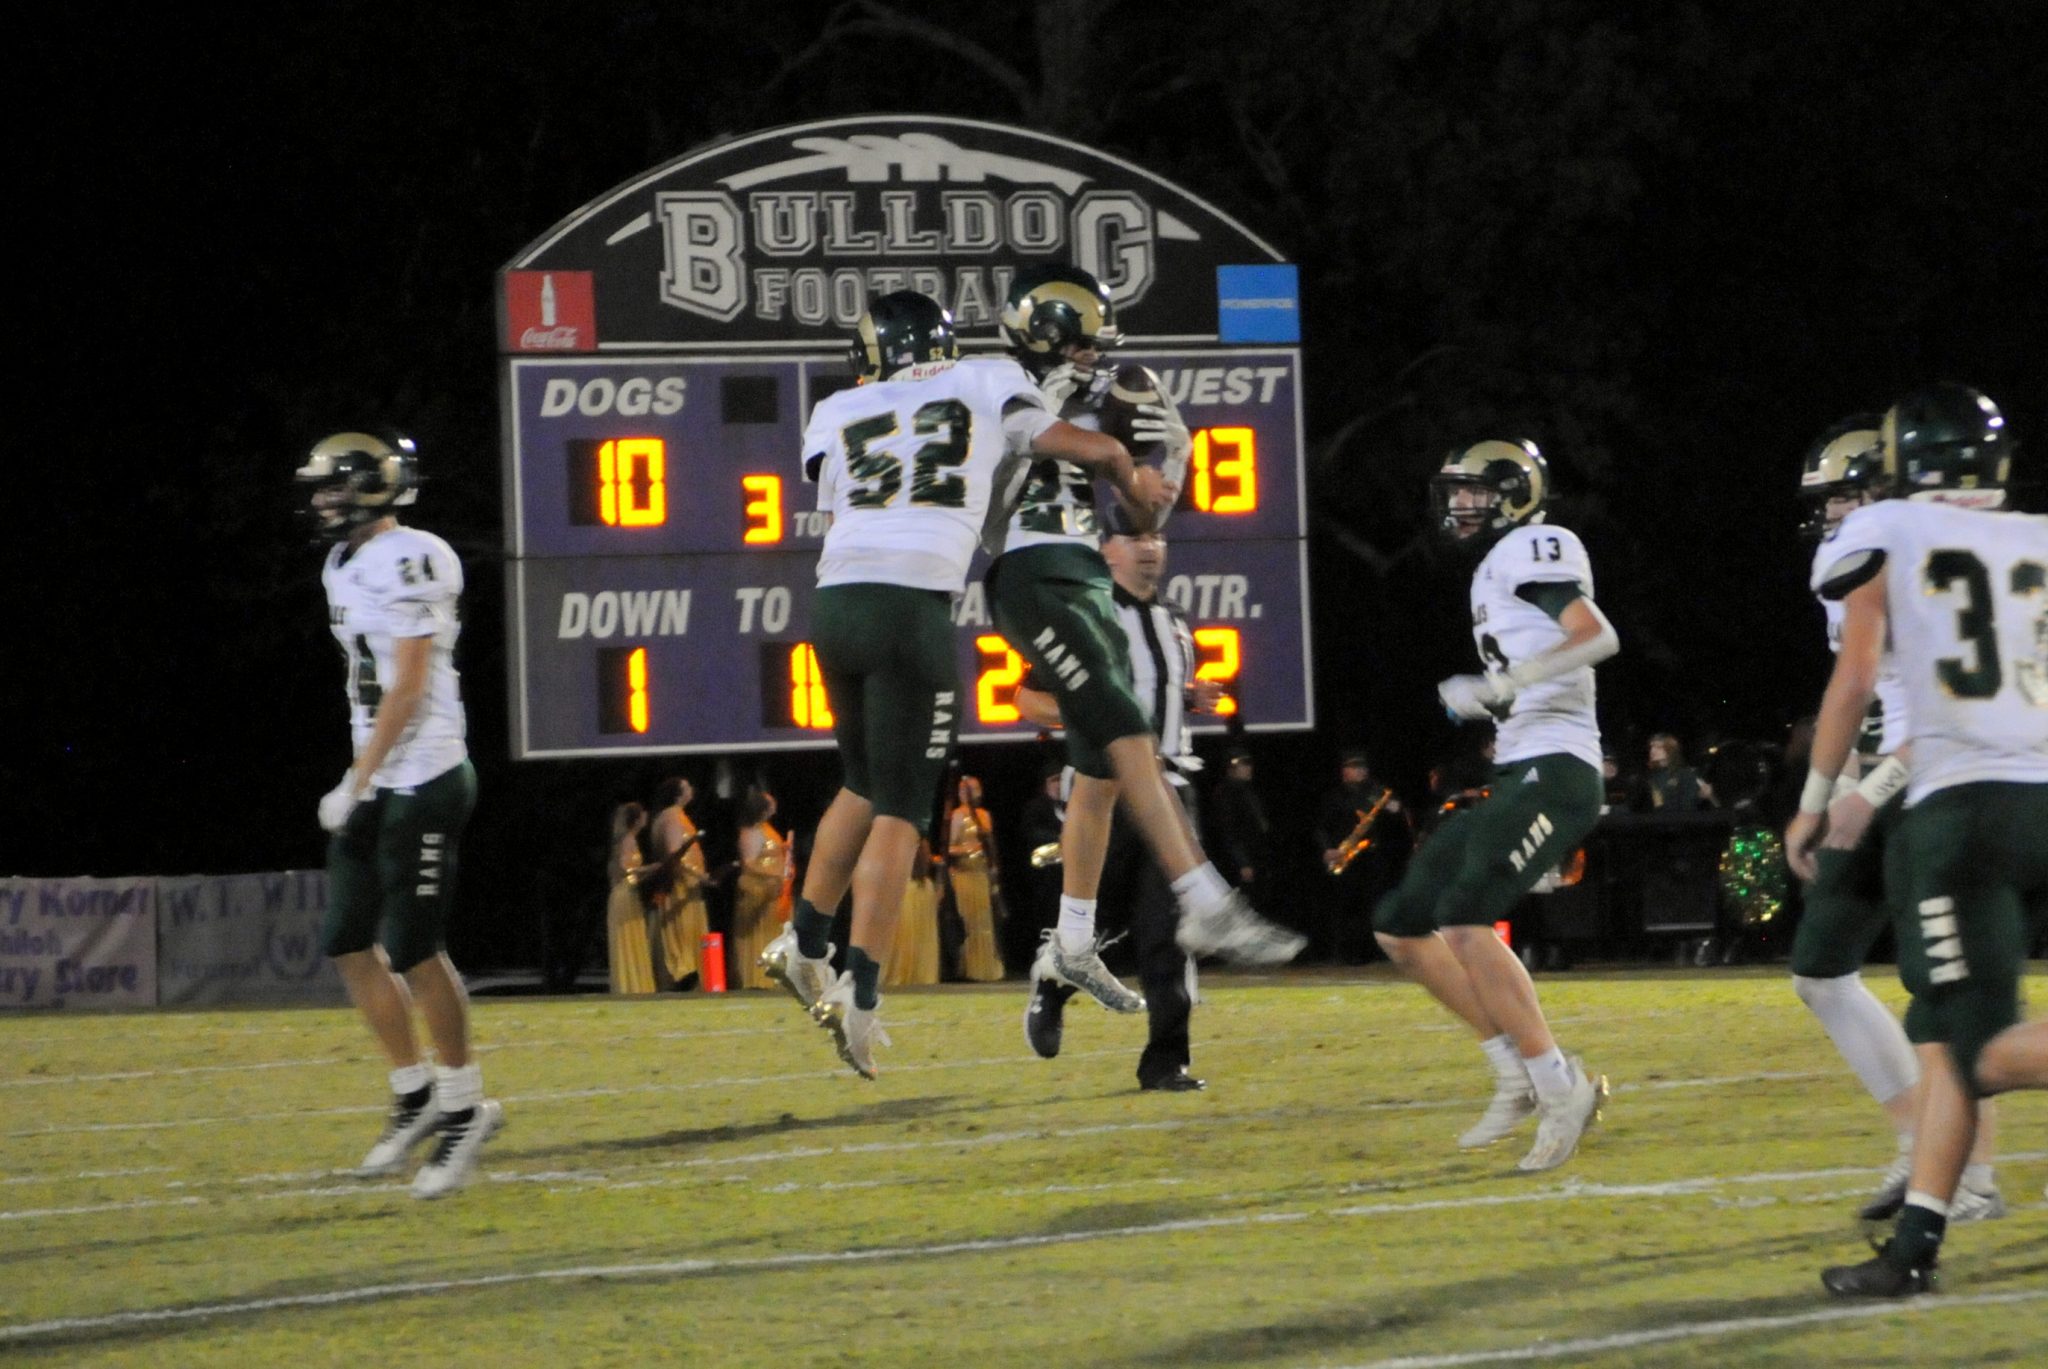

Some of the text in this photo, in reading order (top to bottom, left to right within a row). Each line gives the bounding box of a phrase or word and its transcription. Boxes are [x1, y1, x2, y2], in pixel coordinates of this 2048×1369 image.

[656, 190, 1155, 323] BULLDOG
[540, 378, 687, 418] DOGS
[1160, 366, 1289, 405] UEST
[598, 437, 667, 528] 10
[841, 397, 972, 510] 52
[1191, 426, 1257, 513] 13
[741, 474, 783, 544] 3
[1530, 537, 1562, 562] 13
[558, 589, 691, 638] DOWN
[735, 587, 792, 633] TO
[627, 646, 649, 734] 1
[975, 634, 1024, 724] 2
[925, 691, 954, 760] RAMS
[416, 832, 445, 896] RAMS
